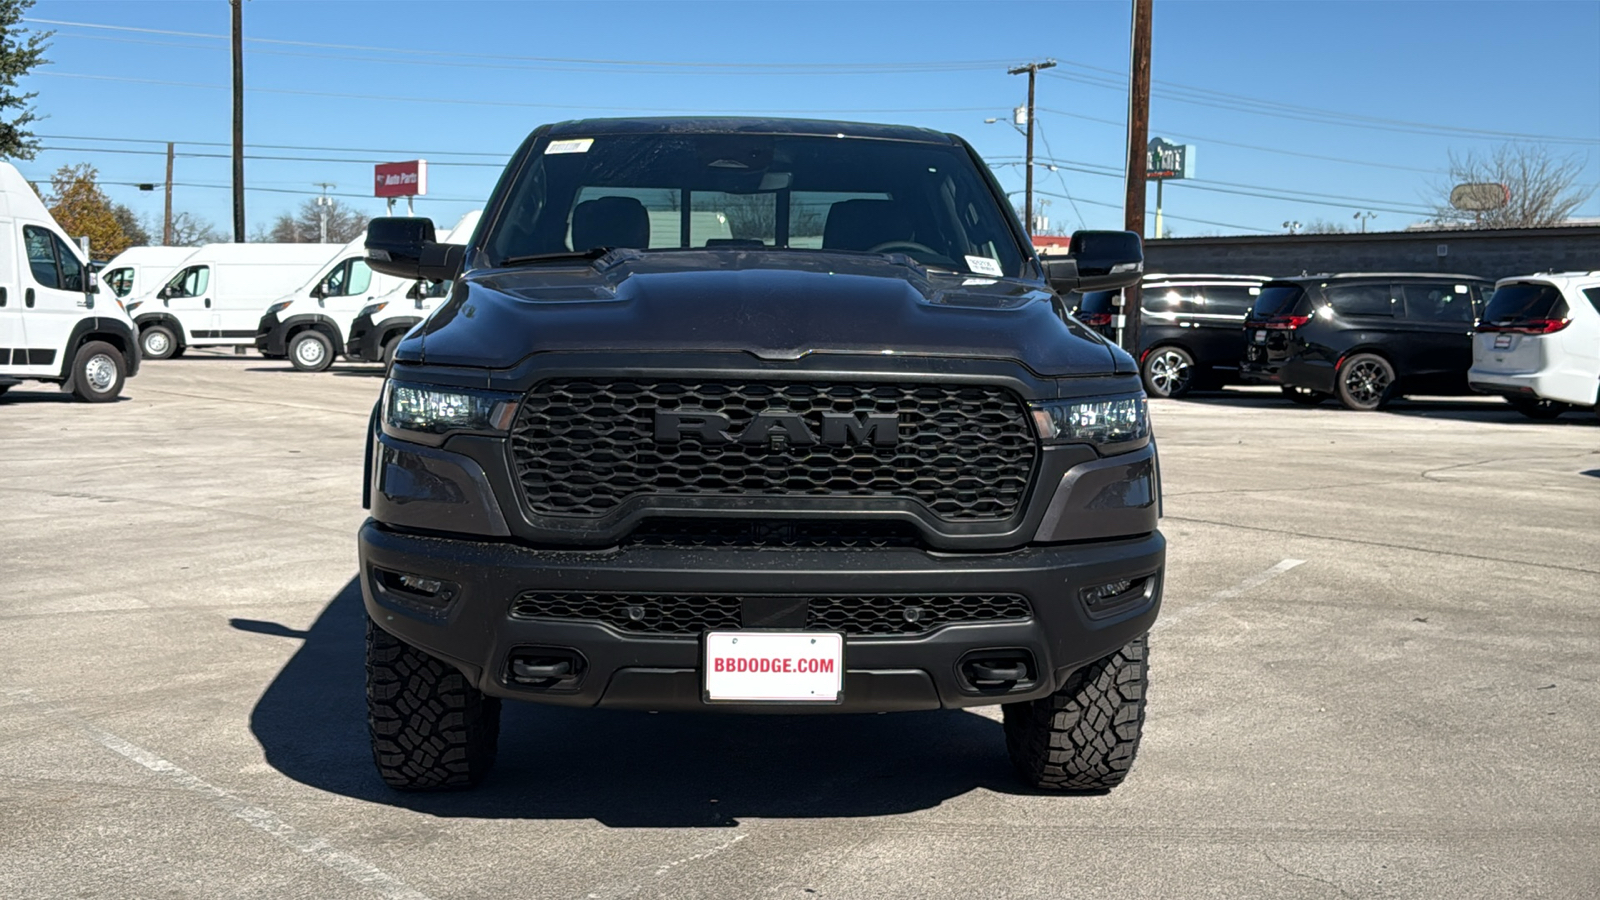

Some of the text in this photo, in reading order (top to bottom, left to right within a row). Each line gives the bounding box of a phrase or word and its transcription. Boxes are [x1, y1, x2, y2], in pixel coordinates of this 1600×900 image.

[385, 172, 417, 185] Auto Parts
[655, 410, 899, 445] RAM
[714, 657, 834, 673] BBDODGE.COM
